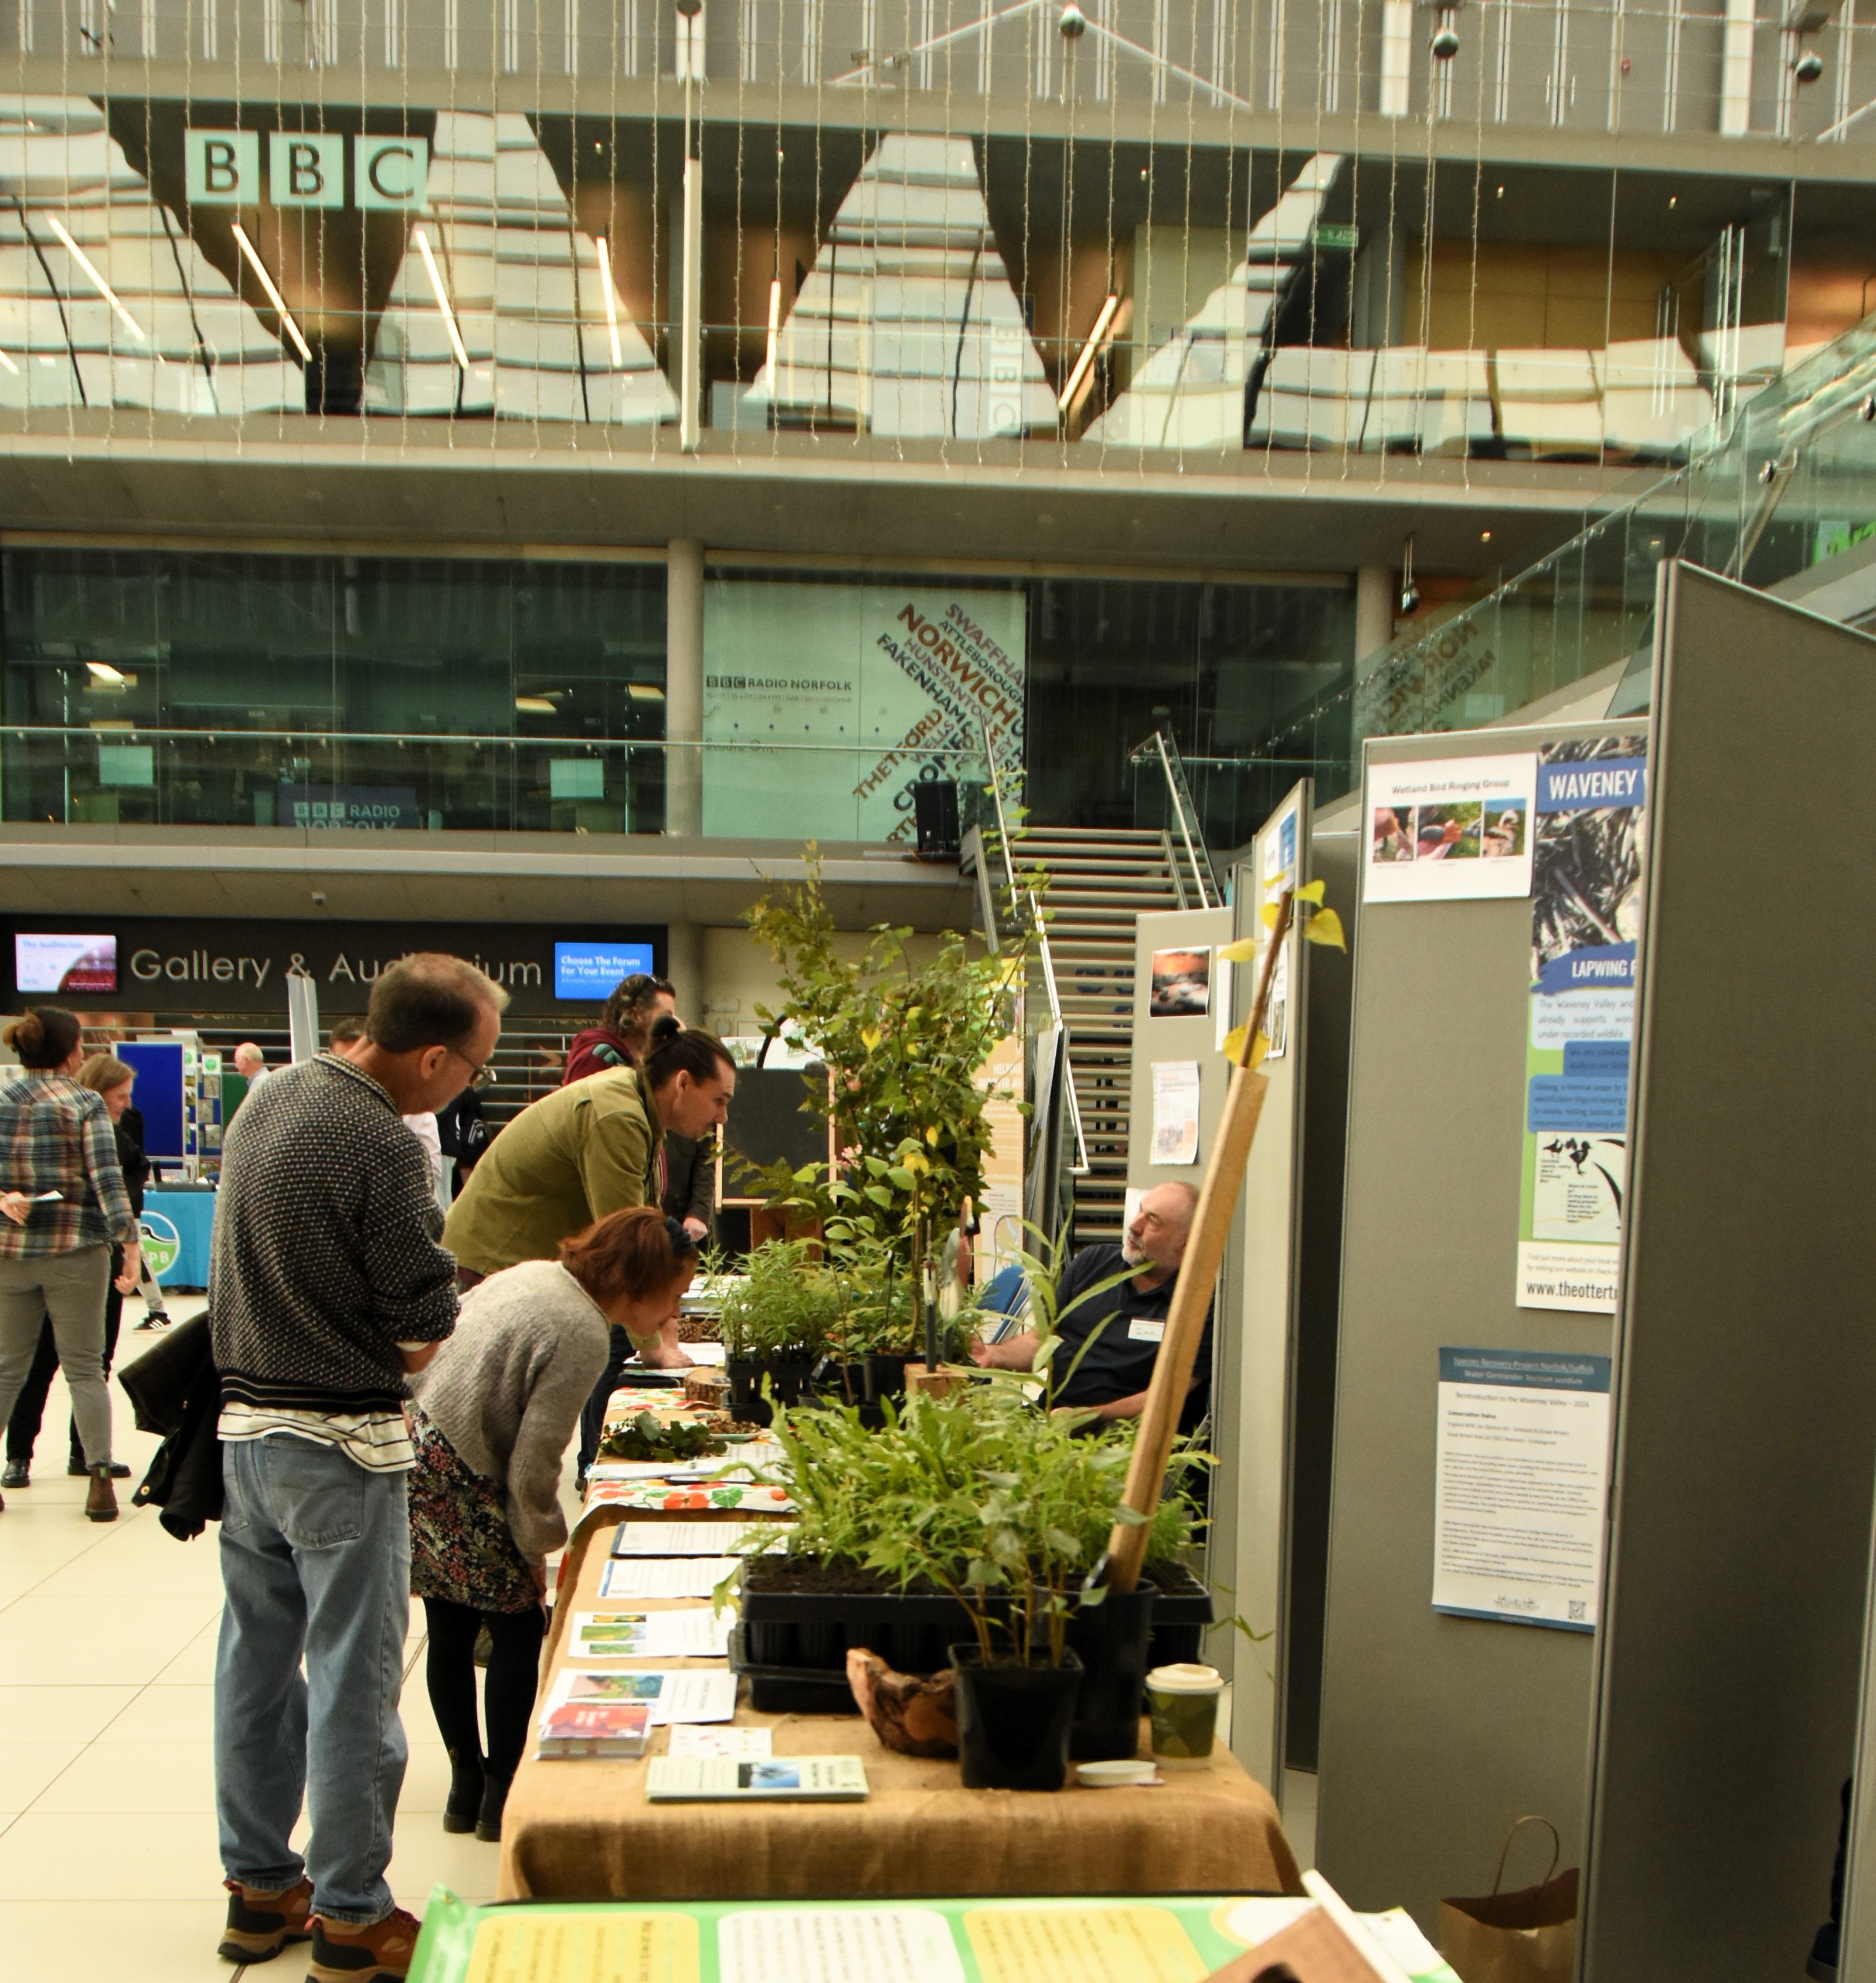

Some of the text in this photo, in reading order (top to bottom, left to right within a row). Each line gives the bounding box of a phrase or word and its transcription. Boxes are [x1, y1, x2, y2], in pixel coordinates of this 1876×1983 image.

[202, 138, 415, 200] BBC
[946, 603, 1024, 689] SWAFFHA
[877, 632, 966, 725] FAKENHAM
[897, 603, 1018, 726] NORWICH
[939, 620, 1024, 708] ATTLEBOROUGH
[706, 675, 851, 691] BBC RADIO NORFOLK
[1391, 778, 1511, 795] Wetland Bird Ringing Group
[1549, 769, 1637, 800] WAVENEY
[294, 802, 400, 818] BBC RADIO
[131, 948, 270, 988] Gallery
[290, 953, 311, 978] &
[561, 955, 640, 966] Choose The Forum
[562, 967, 575, 975] For
[600, 967, 624, 975] Event
[1572, 960, 1627, 978] LAPWING
